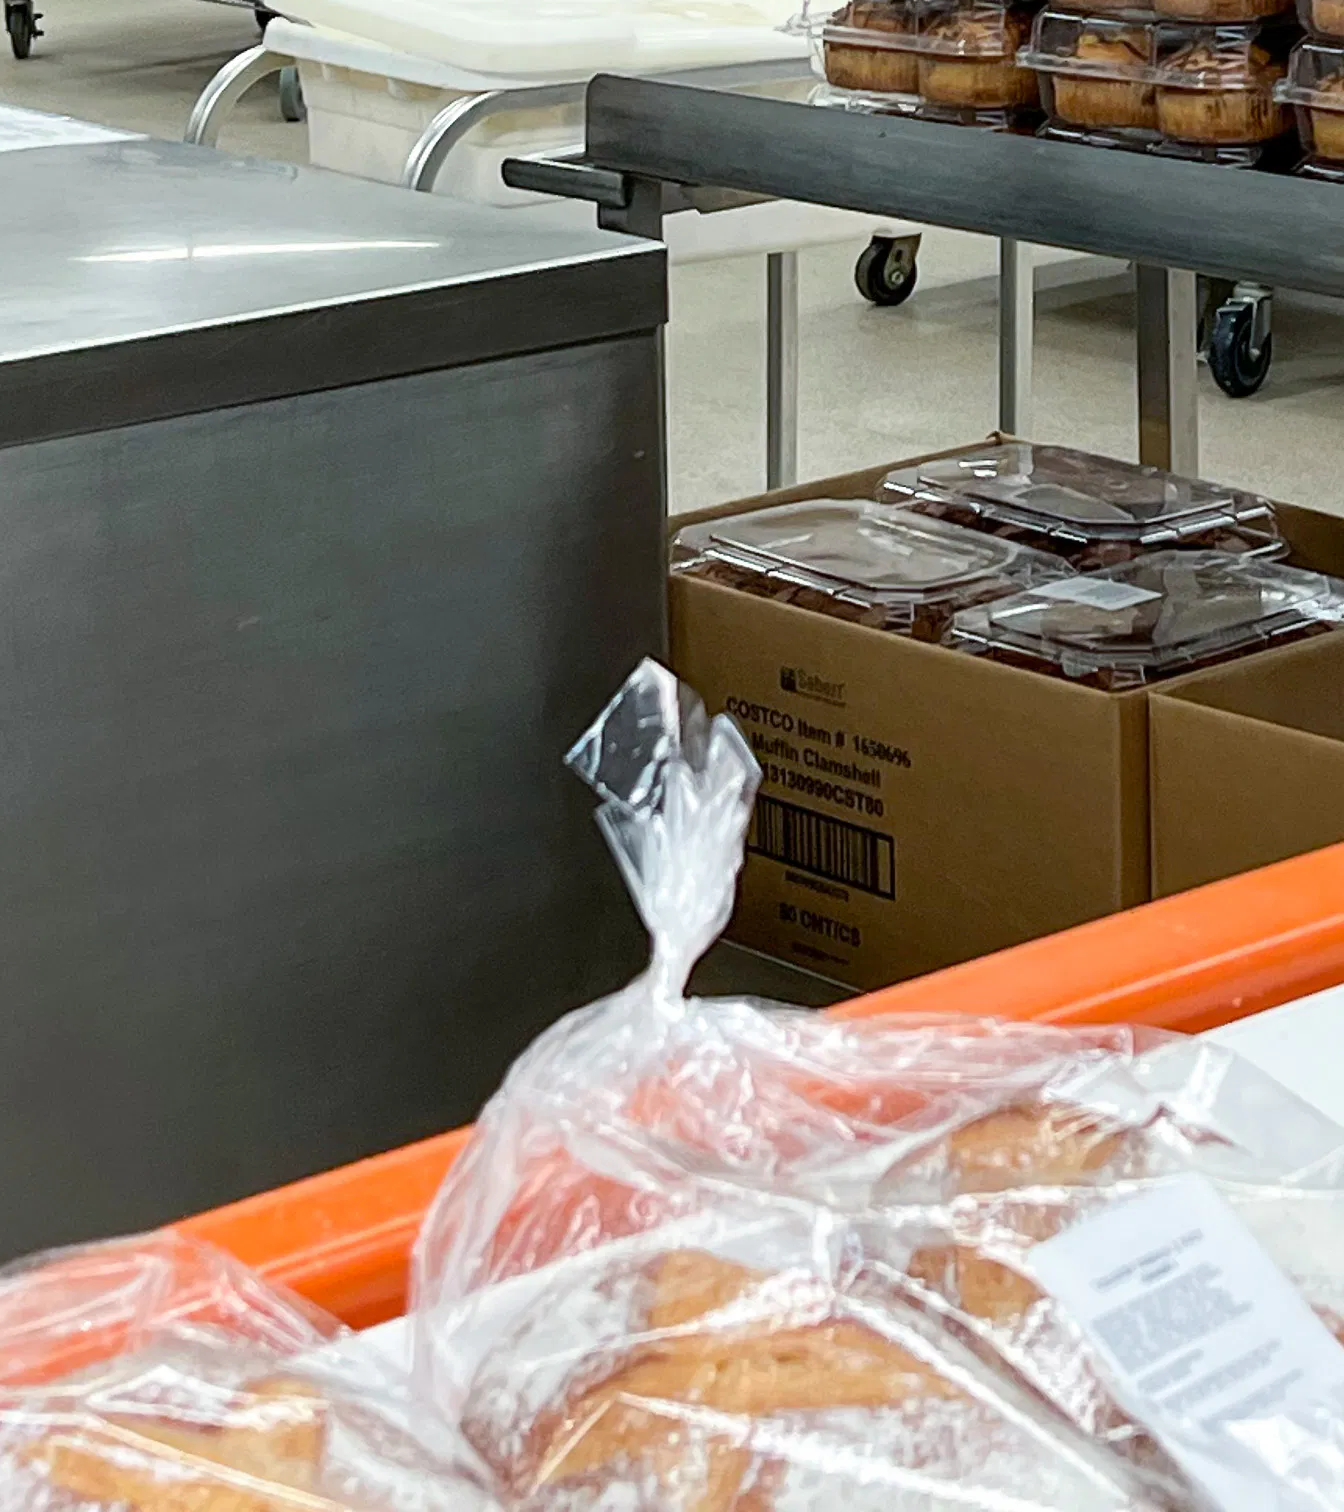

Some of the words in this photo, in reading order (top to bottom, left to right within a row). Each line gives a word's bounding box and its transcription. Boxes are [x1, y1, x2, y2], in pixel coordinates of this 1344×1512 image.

[725, 695, 794, 733] COSTCO
[797, 717, 832, 745] Item
[751, 731, 799, 762] Muffin
[803, 746, 882, 788] Clamshell
